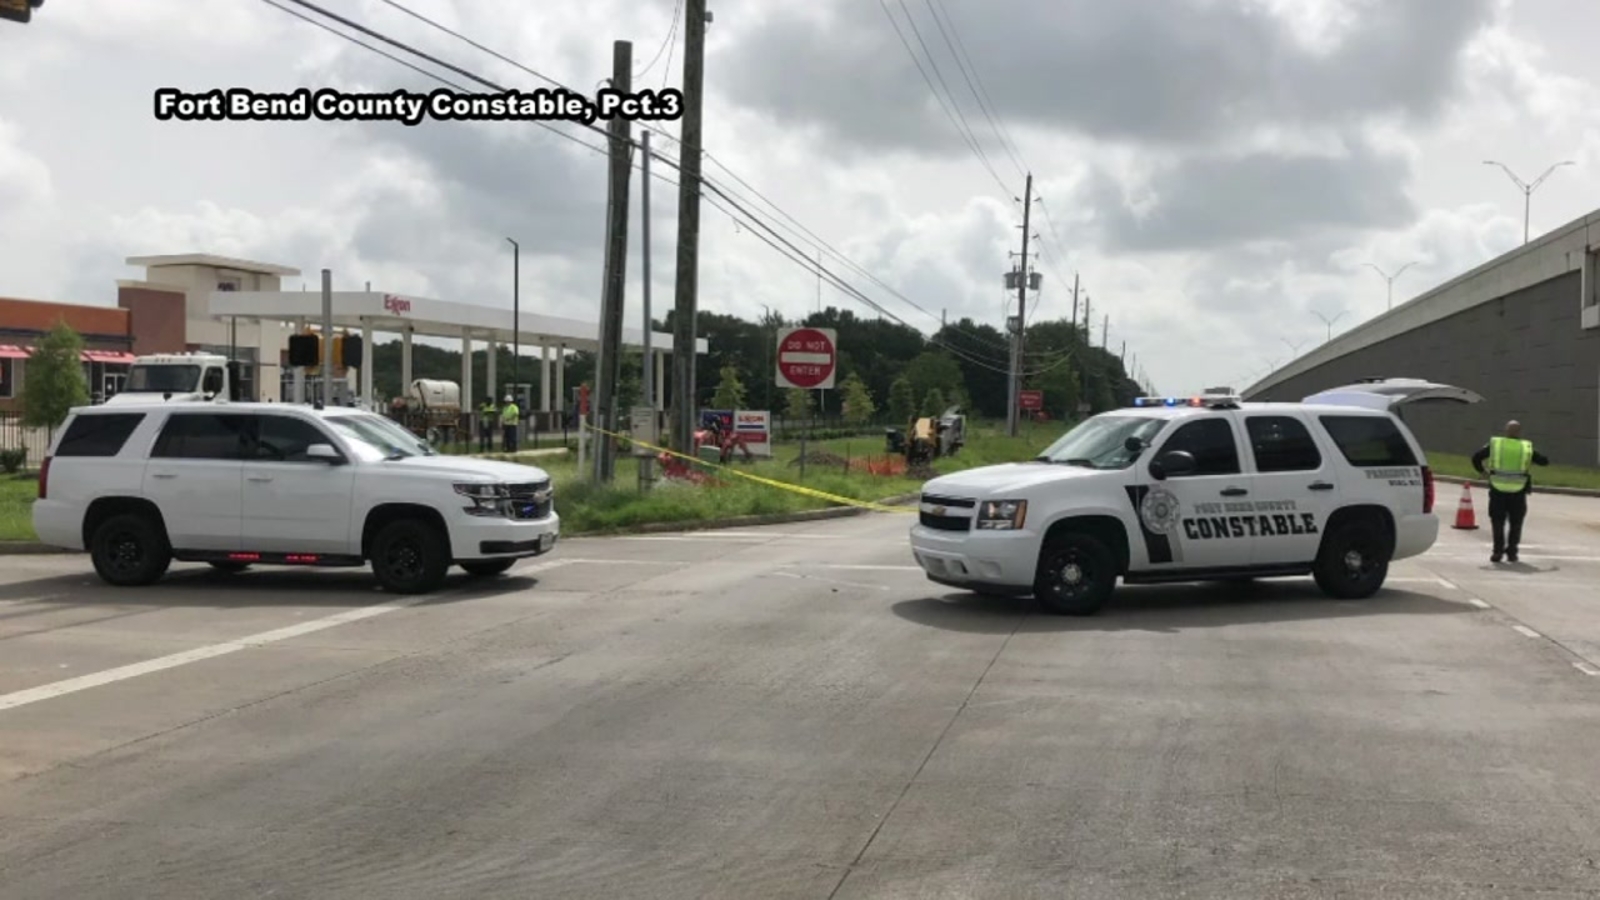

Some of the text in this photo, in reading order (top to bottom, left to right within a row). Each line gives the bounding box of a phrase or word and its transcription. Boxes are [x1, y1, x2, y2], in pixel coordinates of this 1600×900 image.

[787, 341, 825, 351] DO NOT
[789, 366, 821, 376] ENTER
[1193, 502, 1222, 514] FORT
[1254, 499, 1297, 511] COUNTY
[1182, 512, 1319, 540] CONSTABLE
